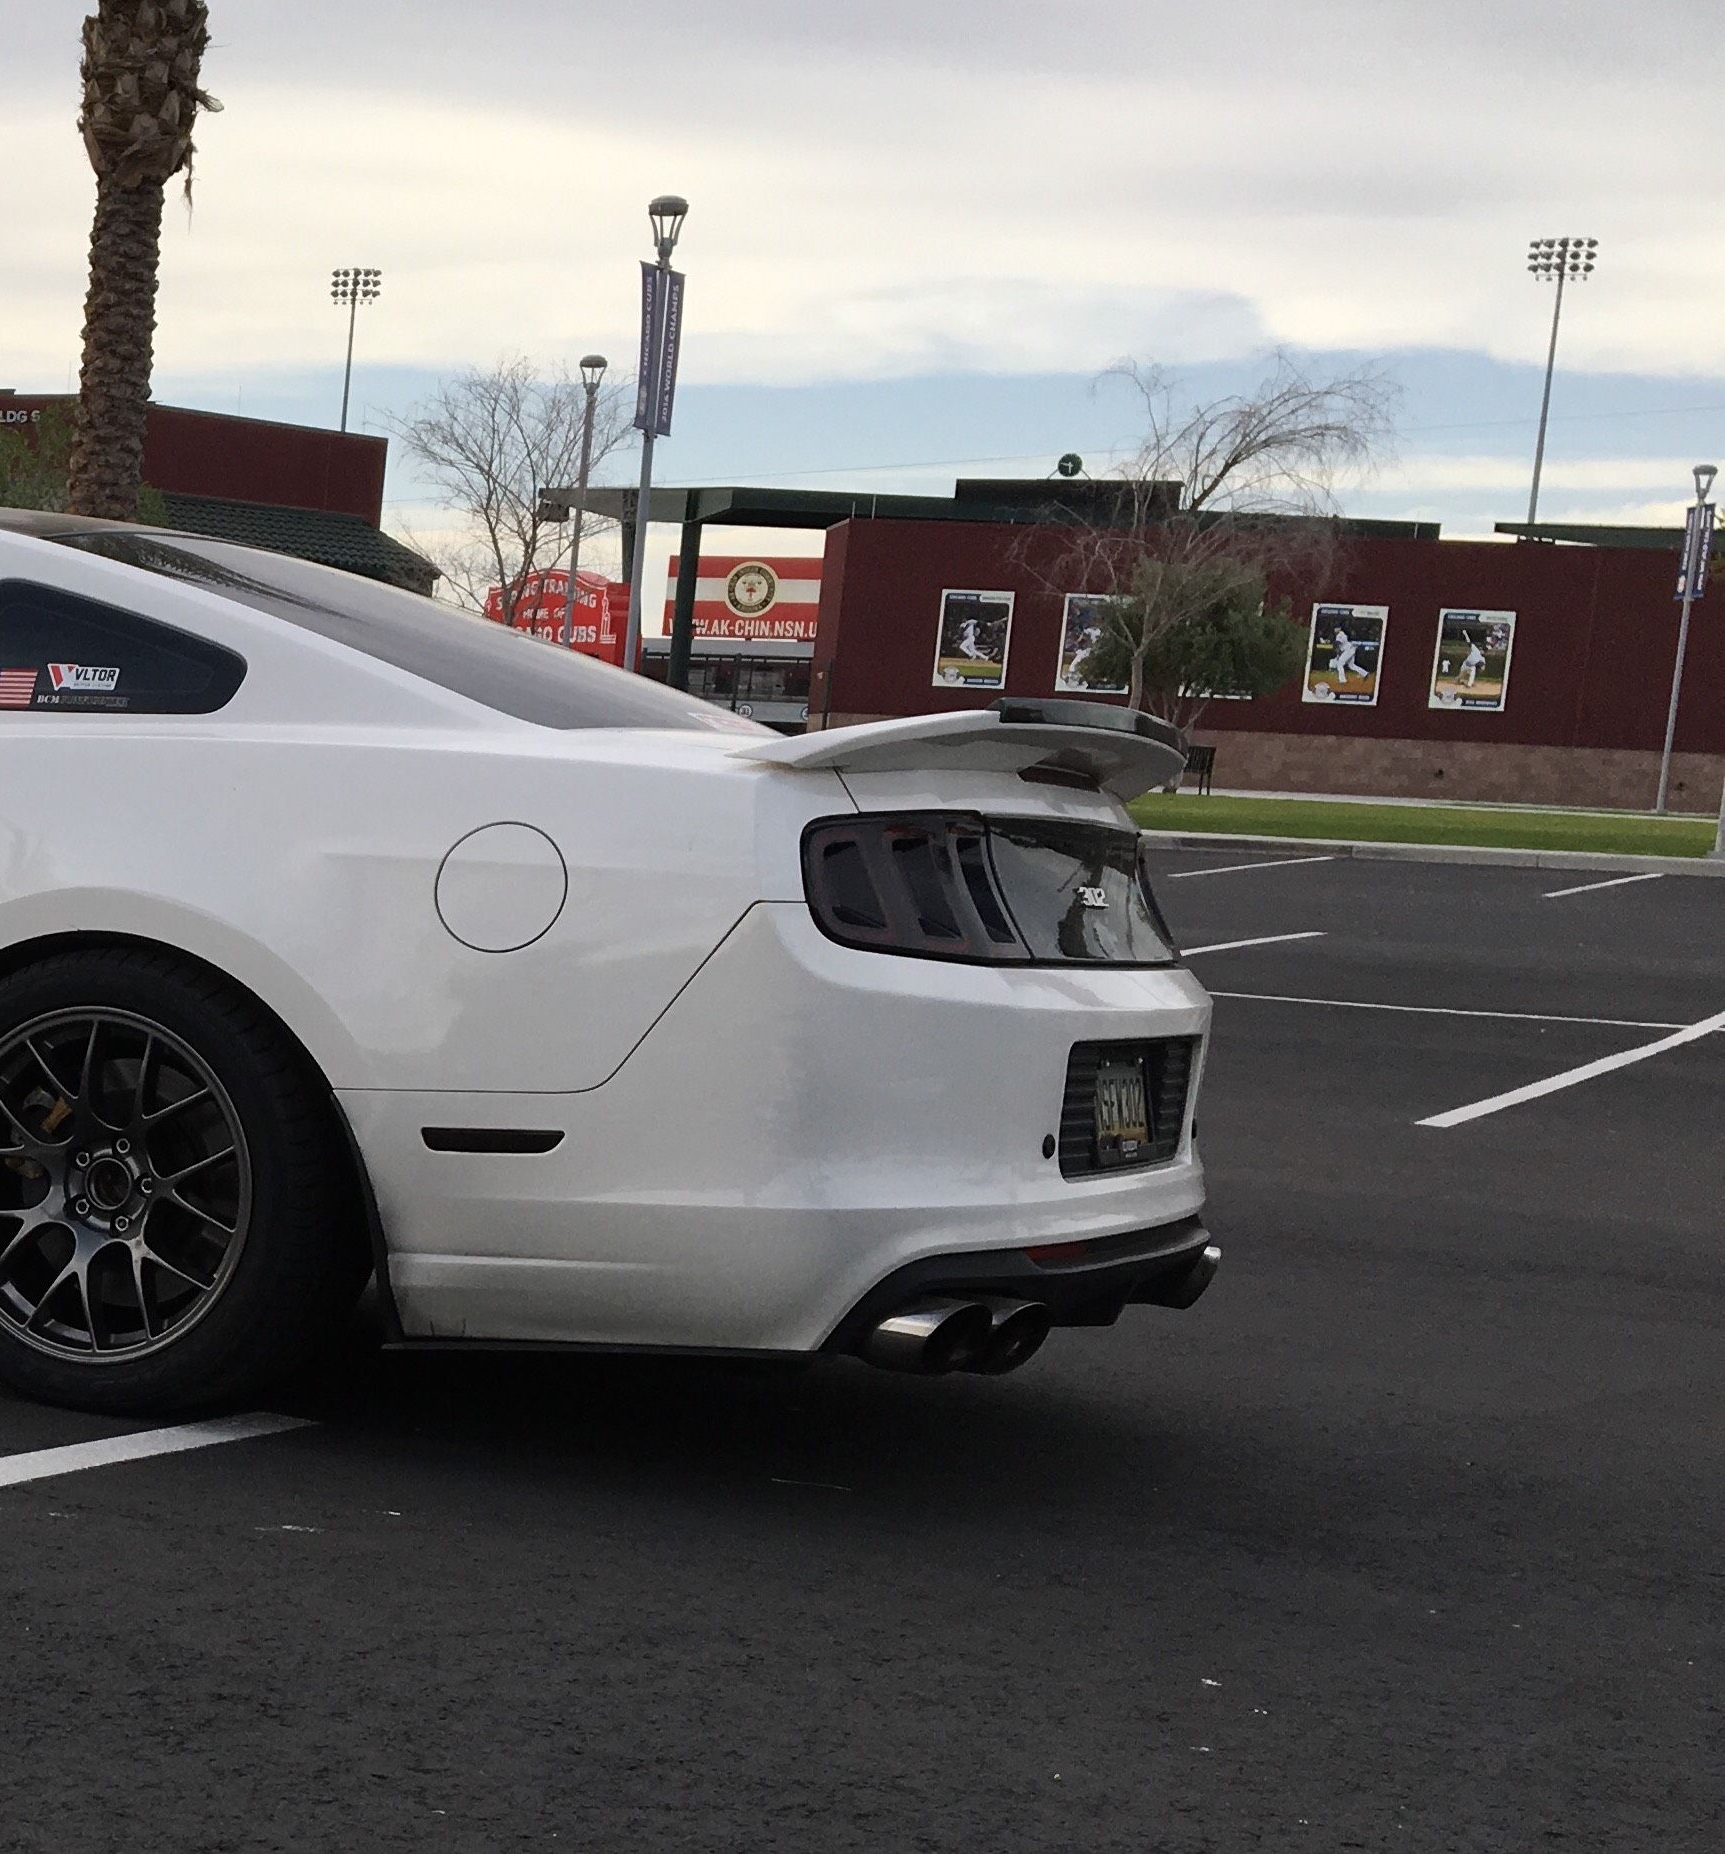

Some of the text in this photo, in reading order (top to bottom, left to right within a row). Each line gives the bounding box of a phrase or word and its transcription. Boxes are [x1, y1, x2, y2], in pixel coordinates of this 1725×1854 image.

[661, 284, 679, 423] 2016 WORLD CHAMPS
[76, 668, 117, 682] VLTOR
